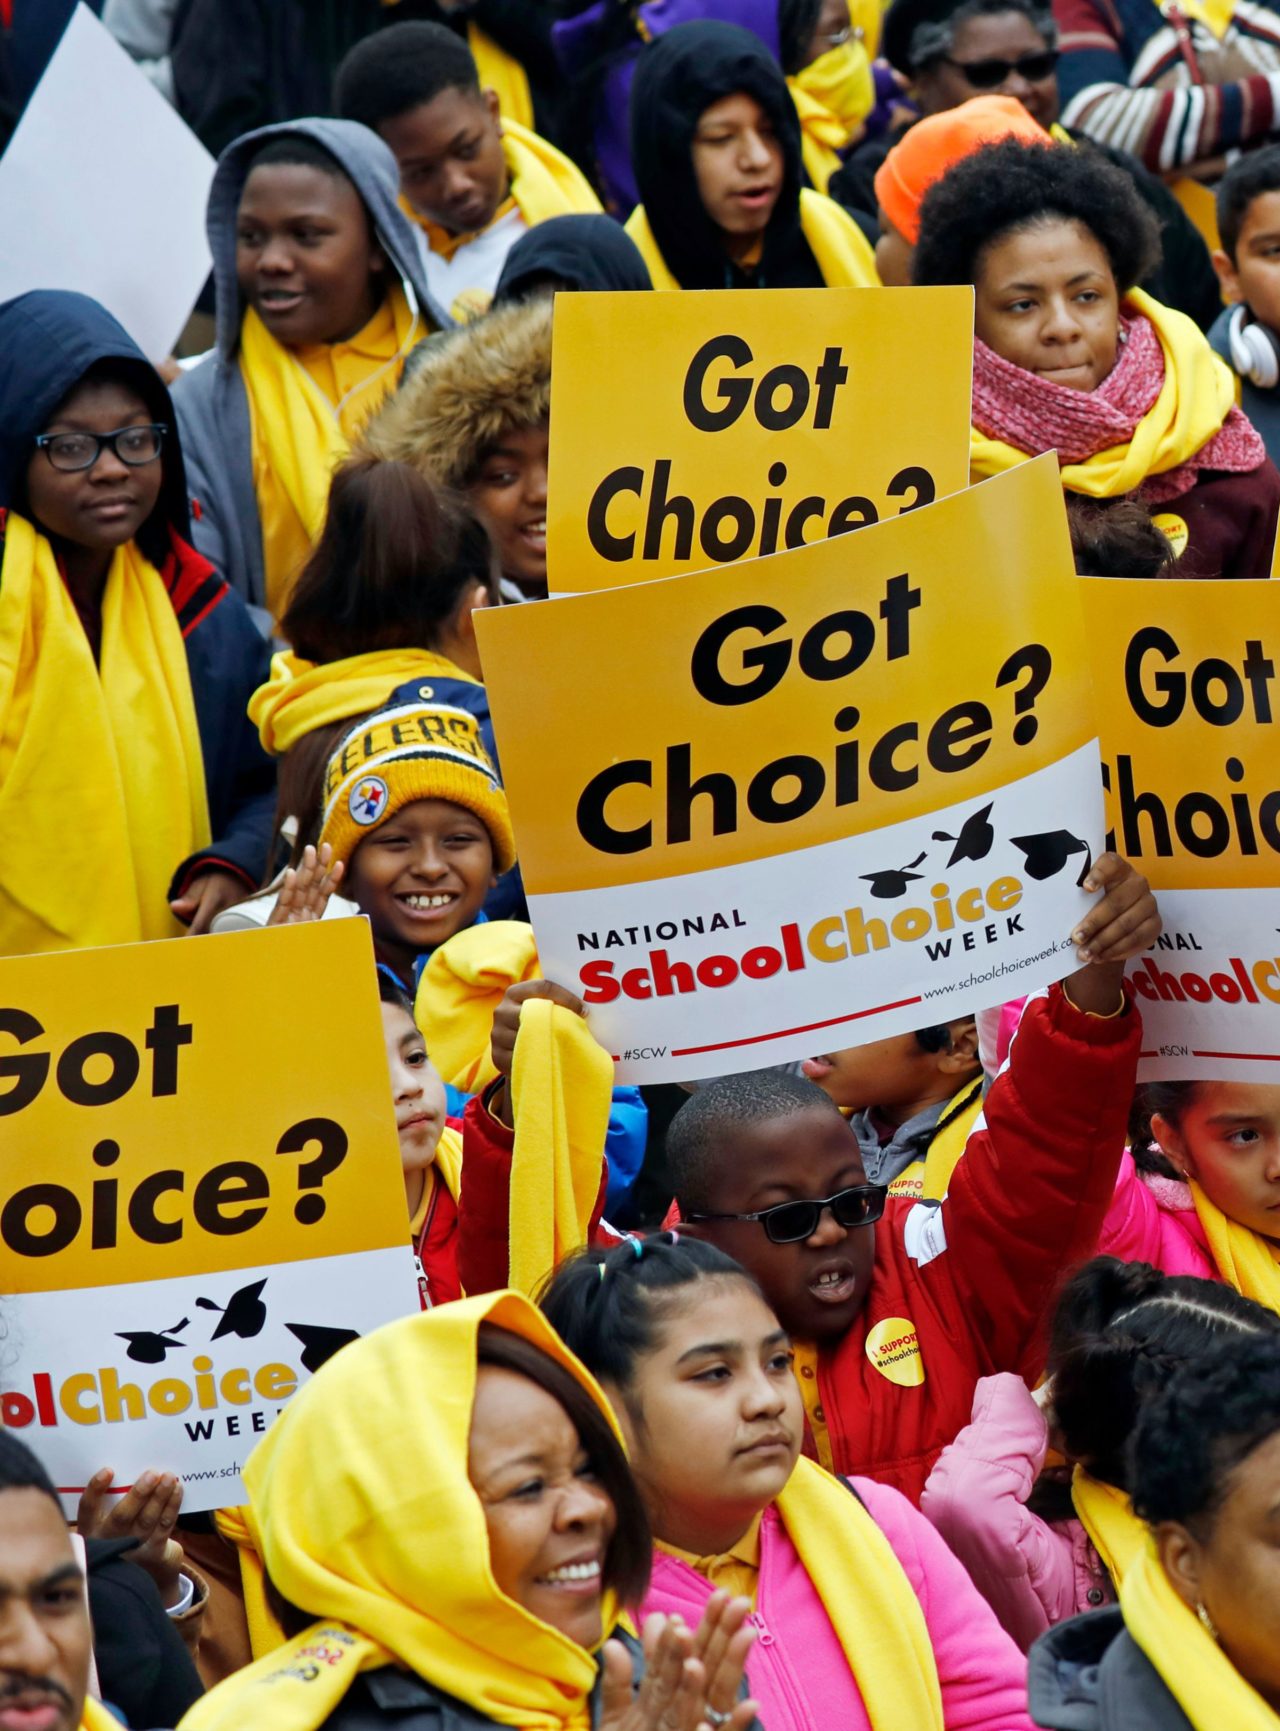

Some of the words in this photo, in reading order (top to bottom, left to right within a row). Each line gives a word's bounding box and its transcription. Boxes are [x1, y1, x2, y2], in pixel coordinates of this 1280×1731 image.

[683, 334, 849, 432] Got
[691, 572, 921, 706] Got
[1125, 626, 1275, 728] Got
[576, 643, 1052, 855] Choice?
[576, 908, 747, 951] NATIONAL
[925, 913, 1026, 962] WEEK
[924, 938, 1073, 1000] www.schoolchoiceweek.co
[0, 1004, 192, 1116] Got
[623, 1046, 667, 1061] #SCW
[1159, 1045, 1189, 1056] #SCW
[0, 1117, 348, 1257] oice?
[879, 1333, 917, 1355] SUPPOR
[0, 1355, 298, 1428] olChoice
[185, 1409, 283, 1441] WEE
